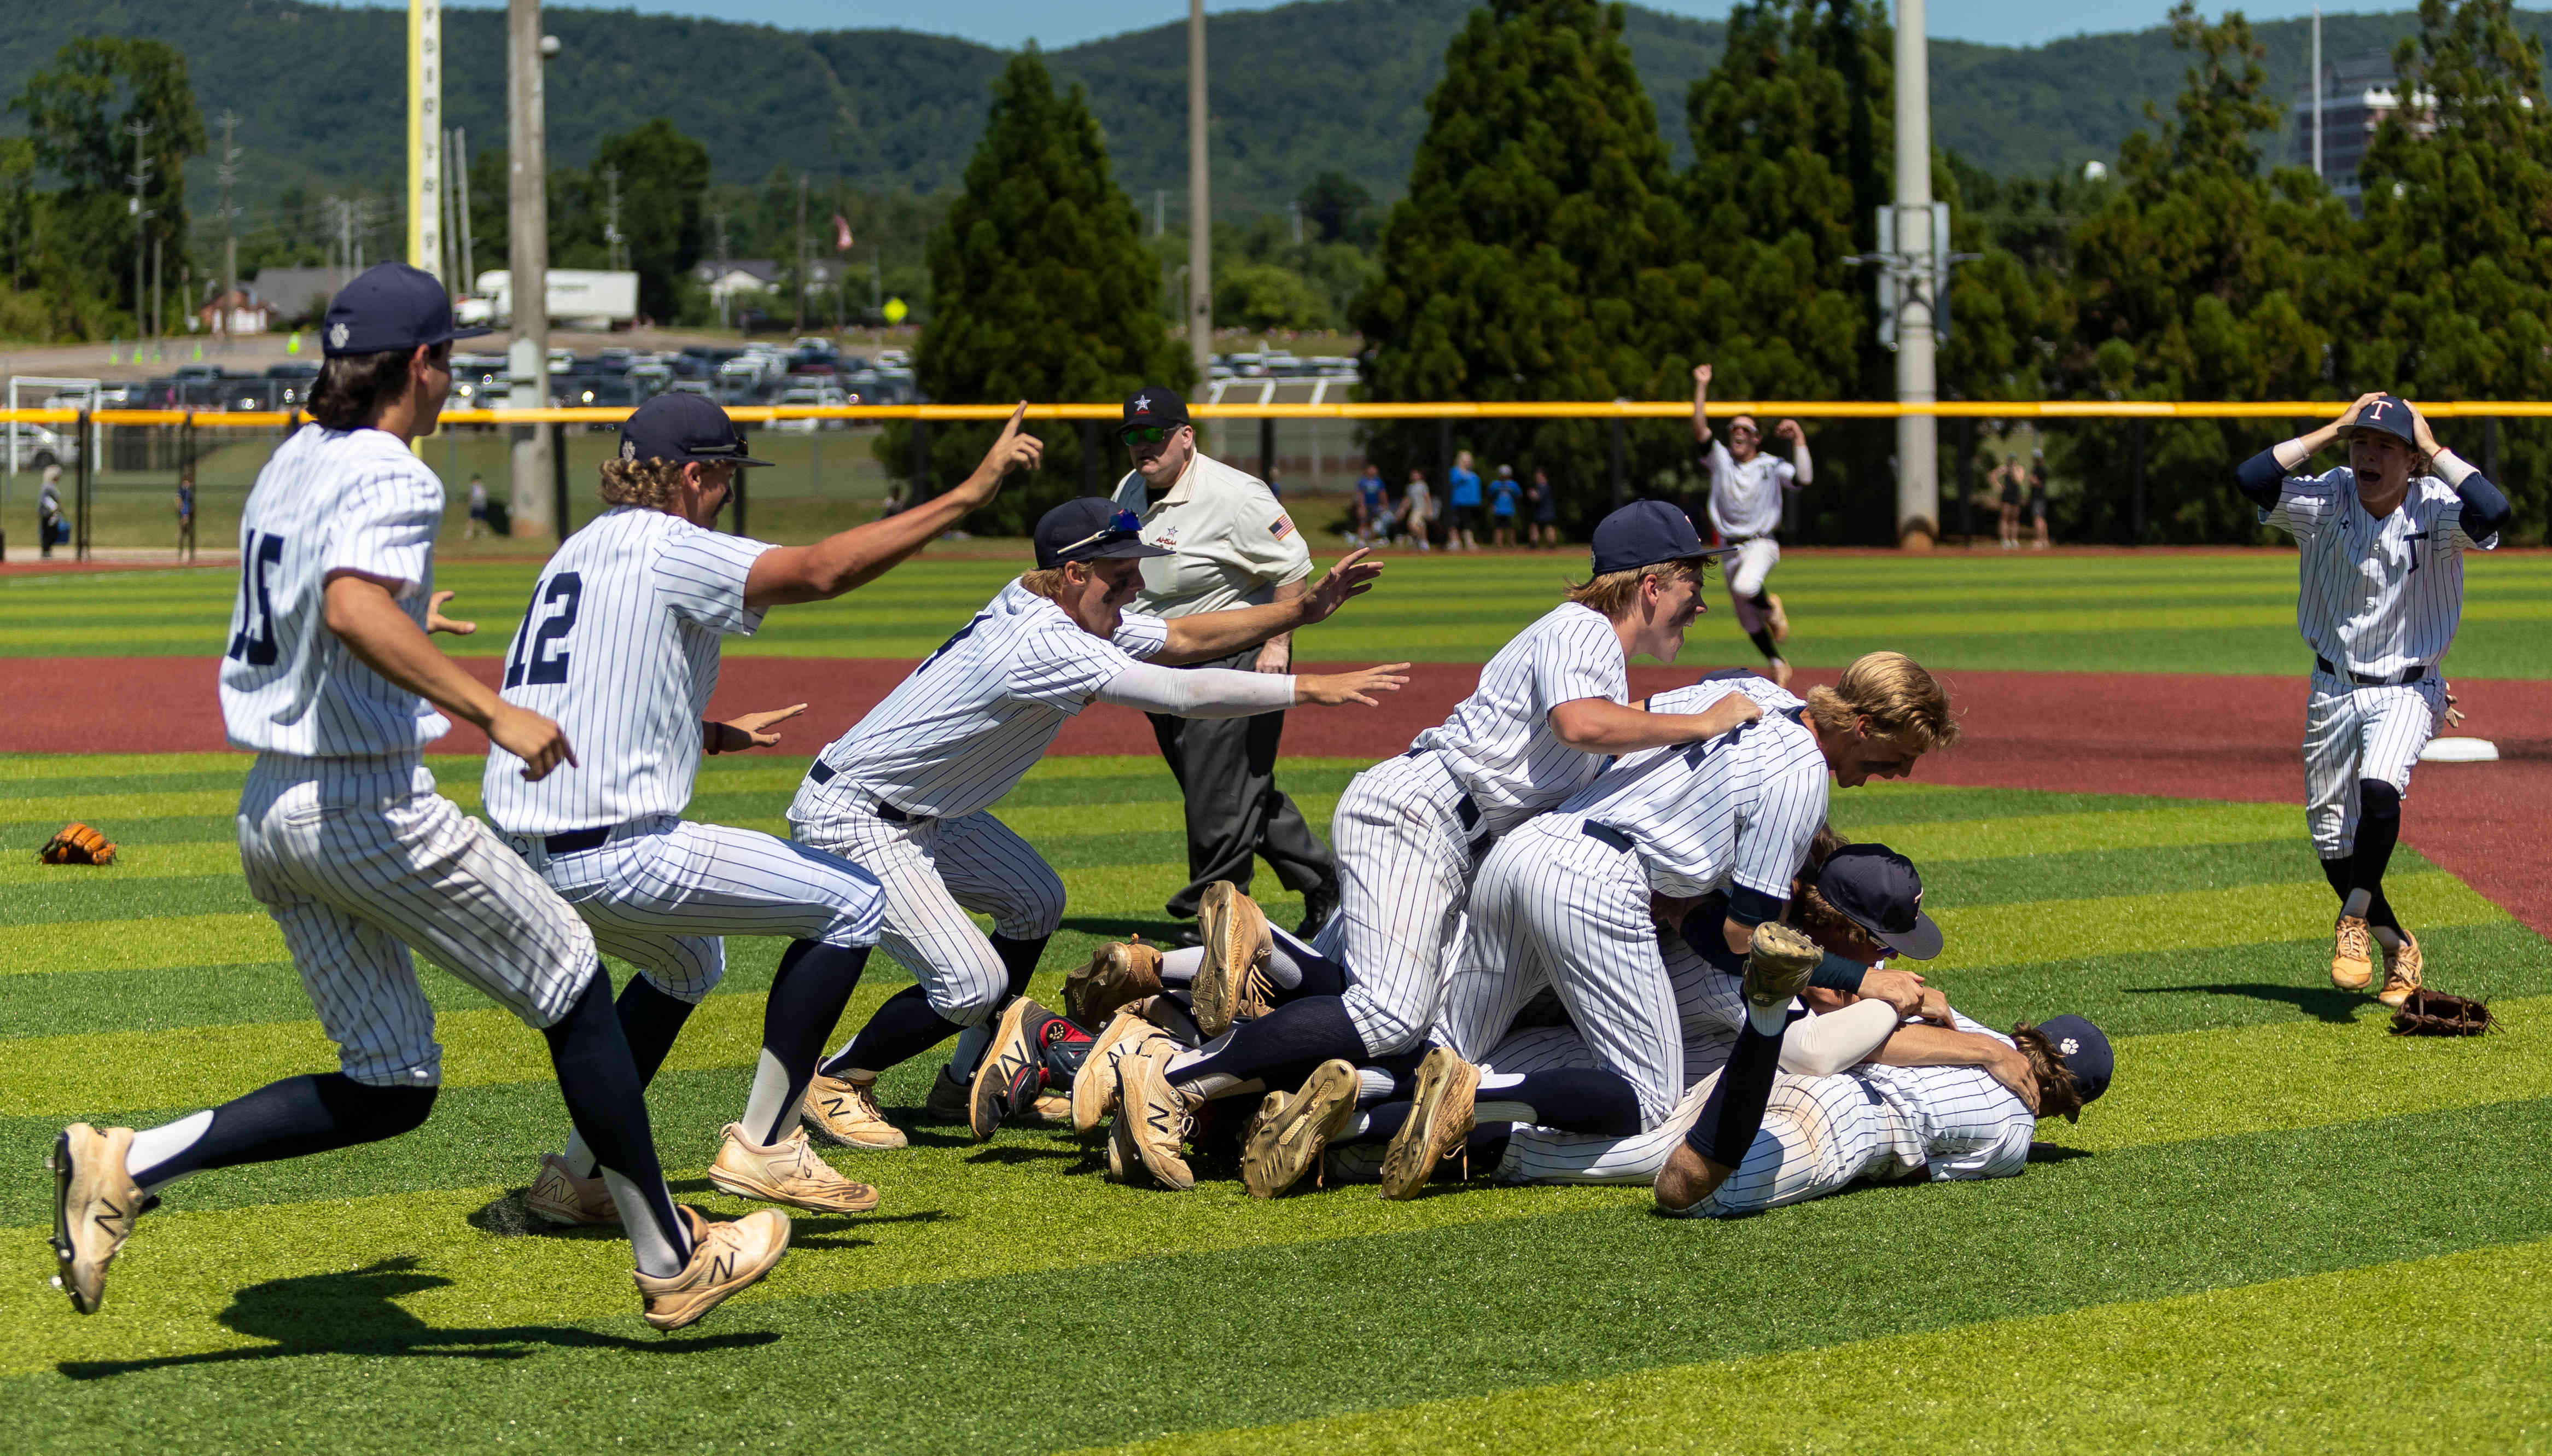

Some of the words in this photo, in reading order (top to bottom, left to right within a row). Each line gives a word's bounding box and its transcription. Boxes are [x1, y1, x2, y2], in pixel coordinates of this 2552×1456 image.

[2370, 400, 2393, 421] T
[2403, 531, 2429, 574] T
[229, 529, 285, 666] 15
[505, 572, 582, 690] 12
[821, 1097, 850, 1118] N
[1147, 1102, 1170, 1134] N
[95, 1197, 123, 1237] N
[709, 1251, 735, 1284] N
